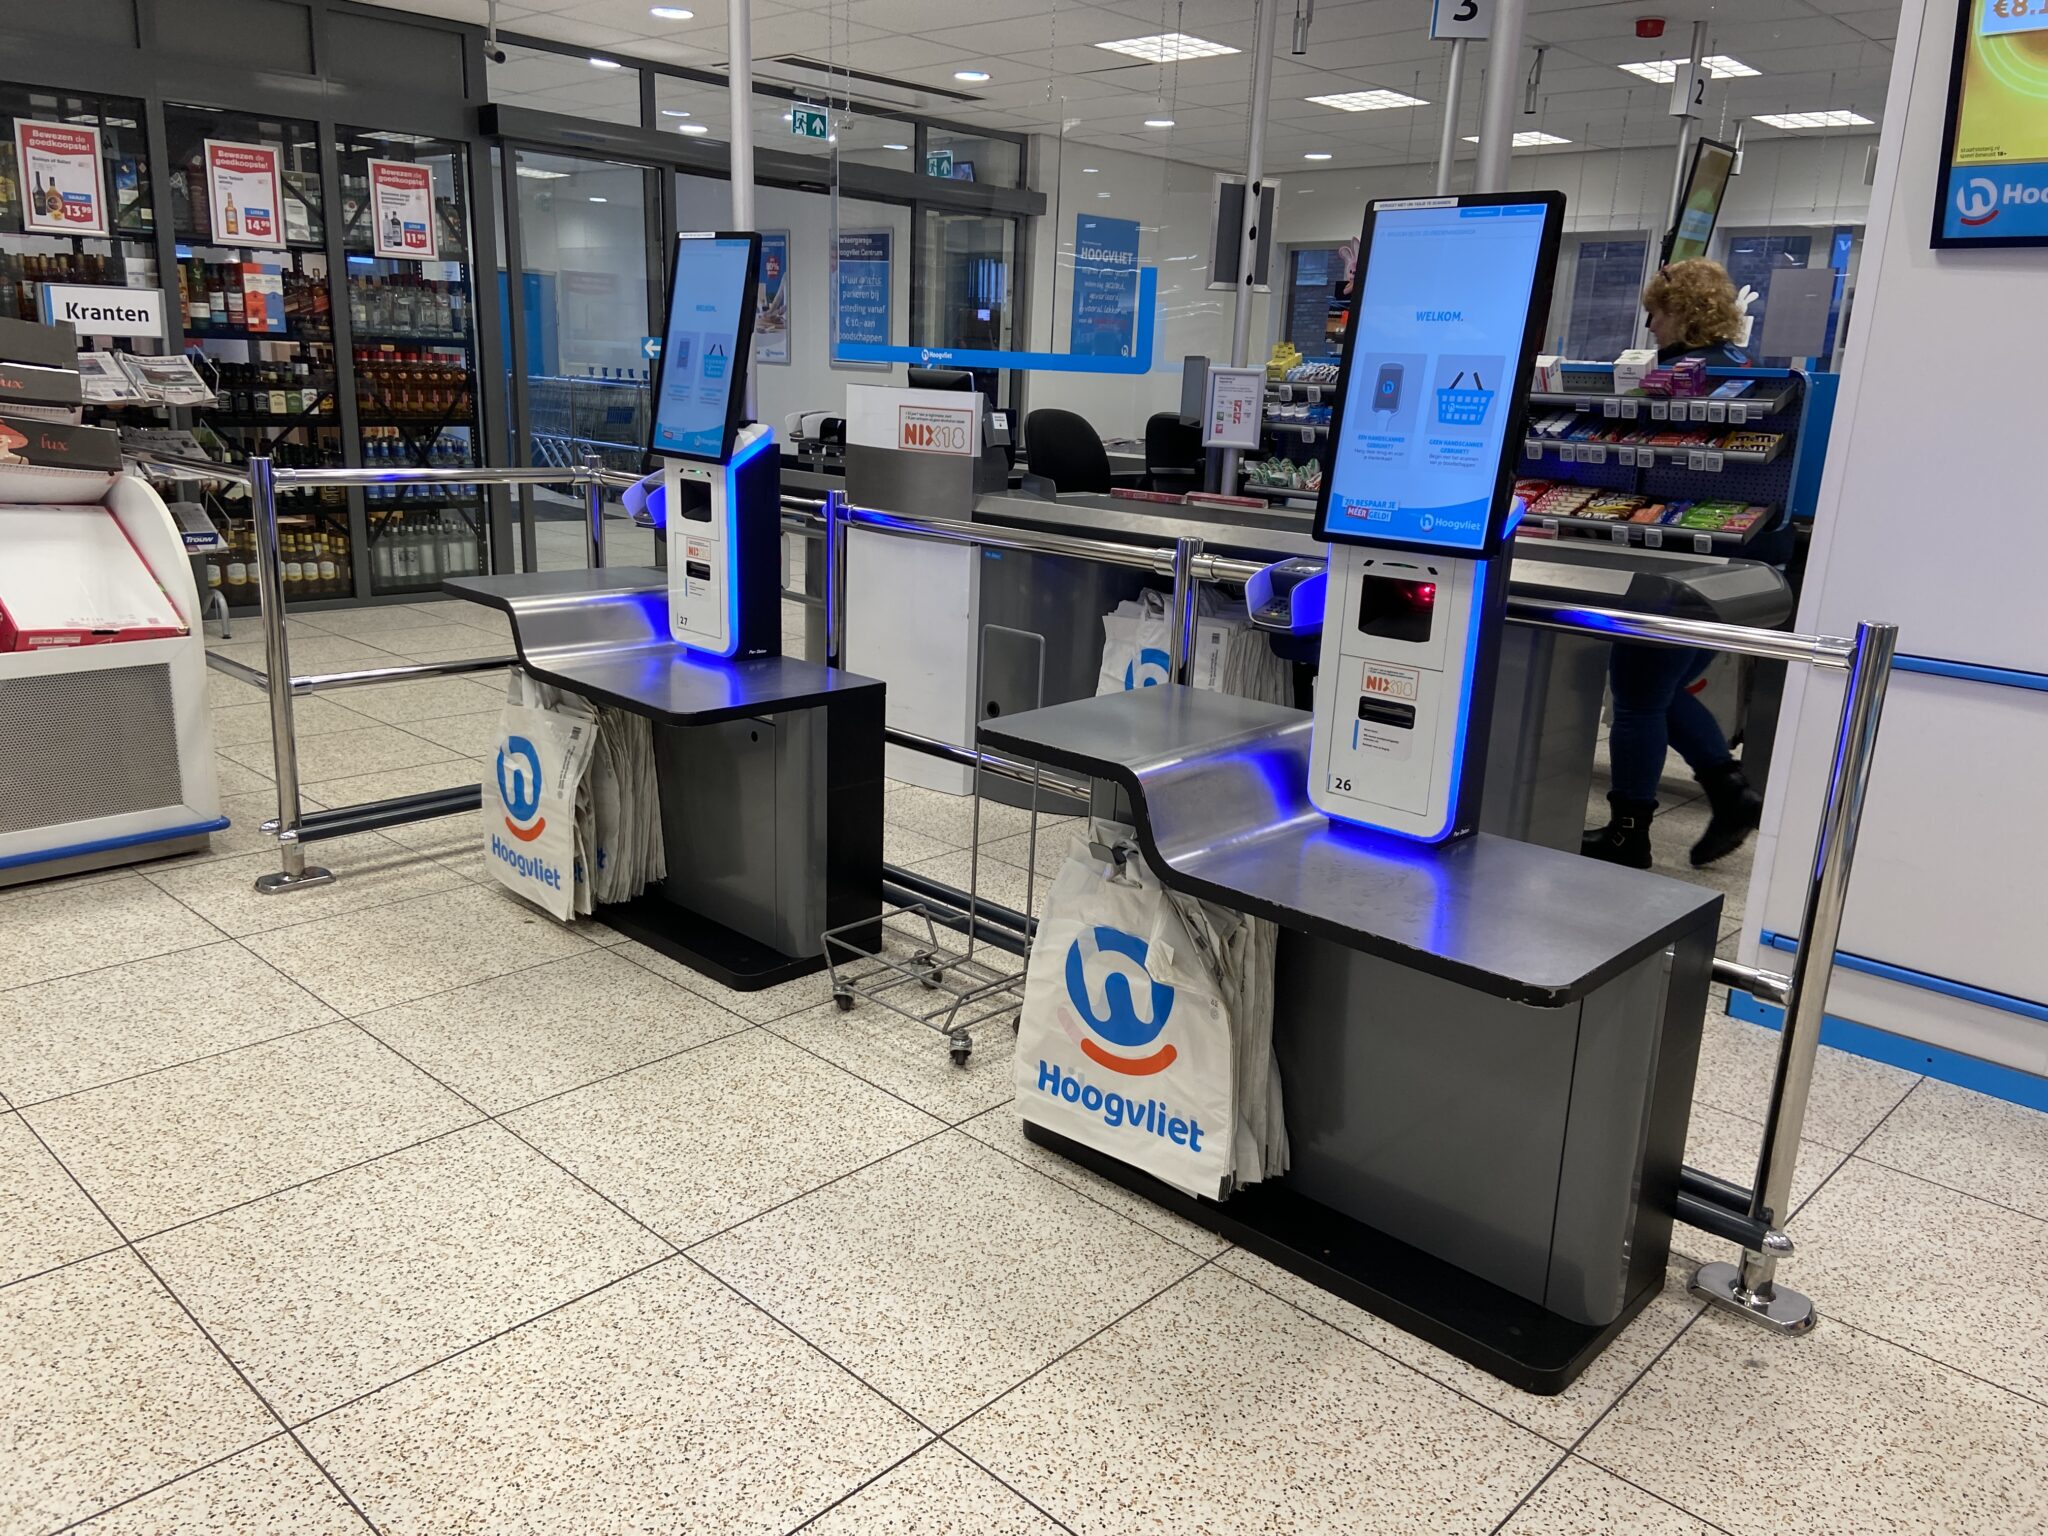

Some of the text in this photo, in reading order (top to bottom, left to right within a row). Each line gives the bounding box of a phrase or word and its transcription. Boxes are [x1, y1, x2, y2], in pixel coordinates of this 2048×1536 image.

[1694, 78, 1705, 105] 2
[32, 129, 86, 143] Bewezen de
[29, 138, 90, 151] goedkoopste!
[218, 150, 253, 161] Bewezen
[215, 158, 268, 170] goedkoopste!
[839, 236, 872, 246] arkeergarage
[840, 248, 860, 257] oogvliet
[1081, 247, 1133, 265] HOOGVLIET
[65, 301, 150, 322] Kranten
[840, 303, 867, 315] esteding
[1416, 311, 1464, 322] WELKOM.
[1356, 499, 1387, 508] BESPAAR
[1435, 518, 1481, 531] Hoogvliet
[680, 616, 688, 626] 27
[1335, 777, 1352, 791] 26
[492, 833, 561, 891] Hoogvliet
[1037, 1059, 1206, 1153] Hoogvliet
